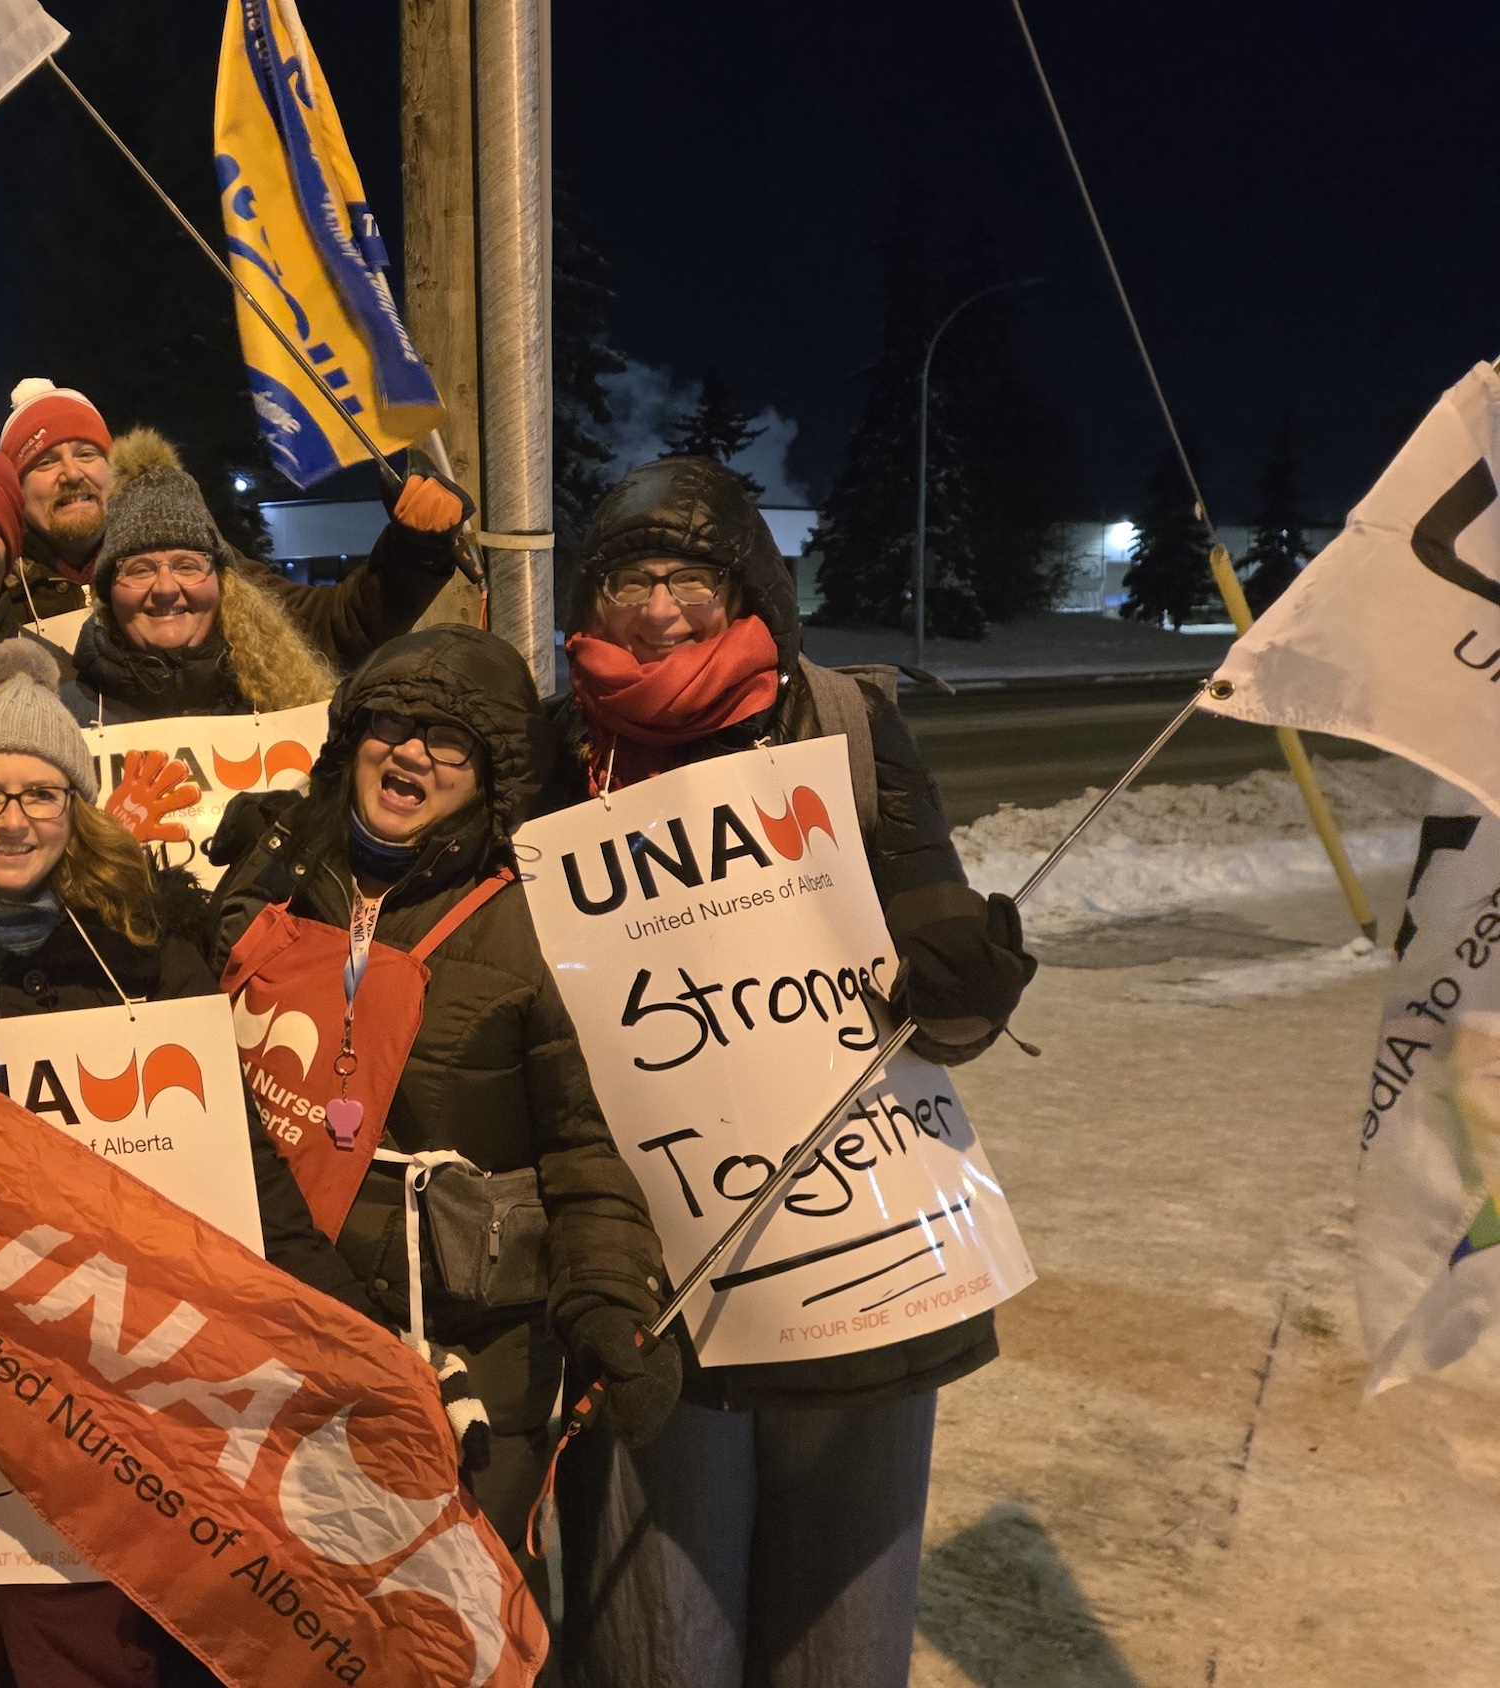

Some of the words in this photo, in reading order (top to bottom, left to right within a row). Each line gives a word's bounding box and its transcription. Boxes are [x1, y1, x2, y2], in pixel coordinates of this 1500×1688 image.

[560, 803, 773, 916] UNA
[625, 907, 695, 940] United
[699, 889, 775, 921] Nurses
[779, 878, 796, 899] of
[797, 871, 834, 895] Alberta
[621, 956, 887, 1072] Stronger
[252, 1068, 328, 1127] Nurse
[103, 1134, 173, 1157] Alberta
[638, 1093, 953, 1217] Together
[780, 1327, 796, 1342] AT
[799, 1320, 848, 1341] YOUR
[851, 1309, 890, 1332] SIDE
[904, 1302, 928, 1318] ON
[930, 1284, 967, 1309] YOUR
[967, 1272, 992, 1296] SIDE
[47, 1394, 184, 1519] Nurses
[189, 1516, 242, 1558] of
[230, 1554, 368, 1687] Alberta
